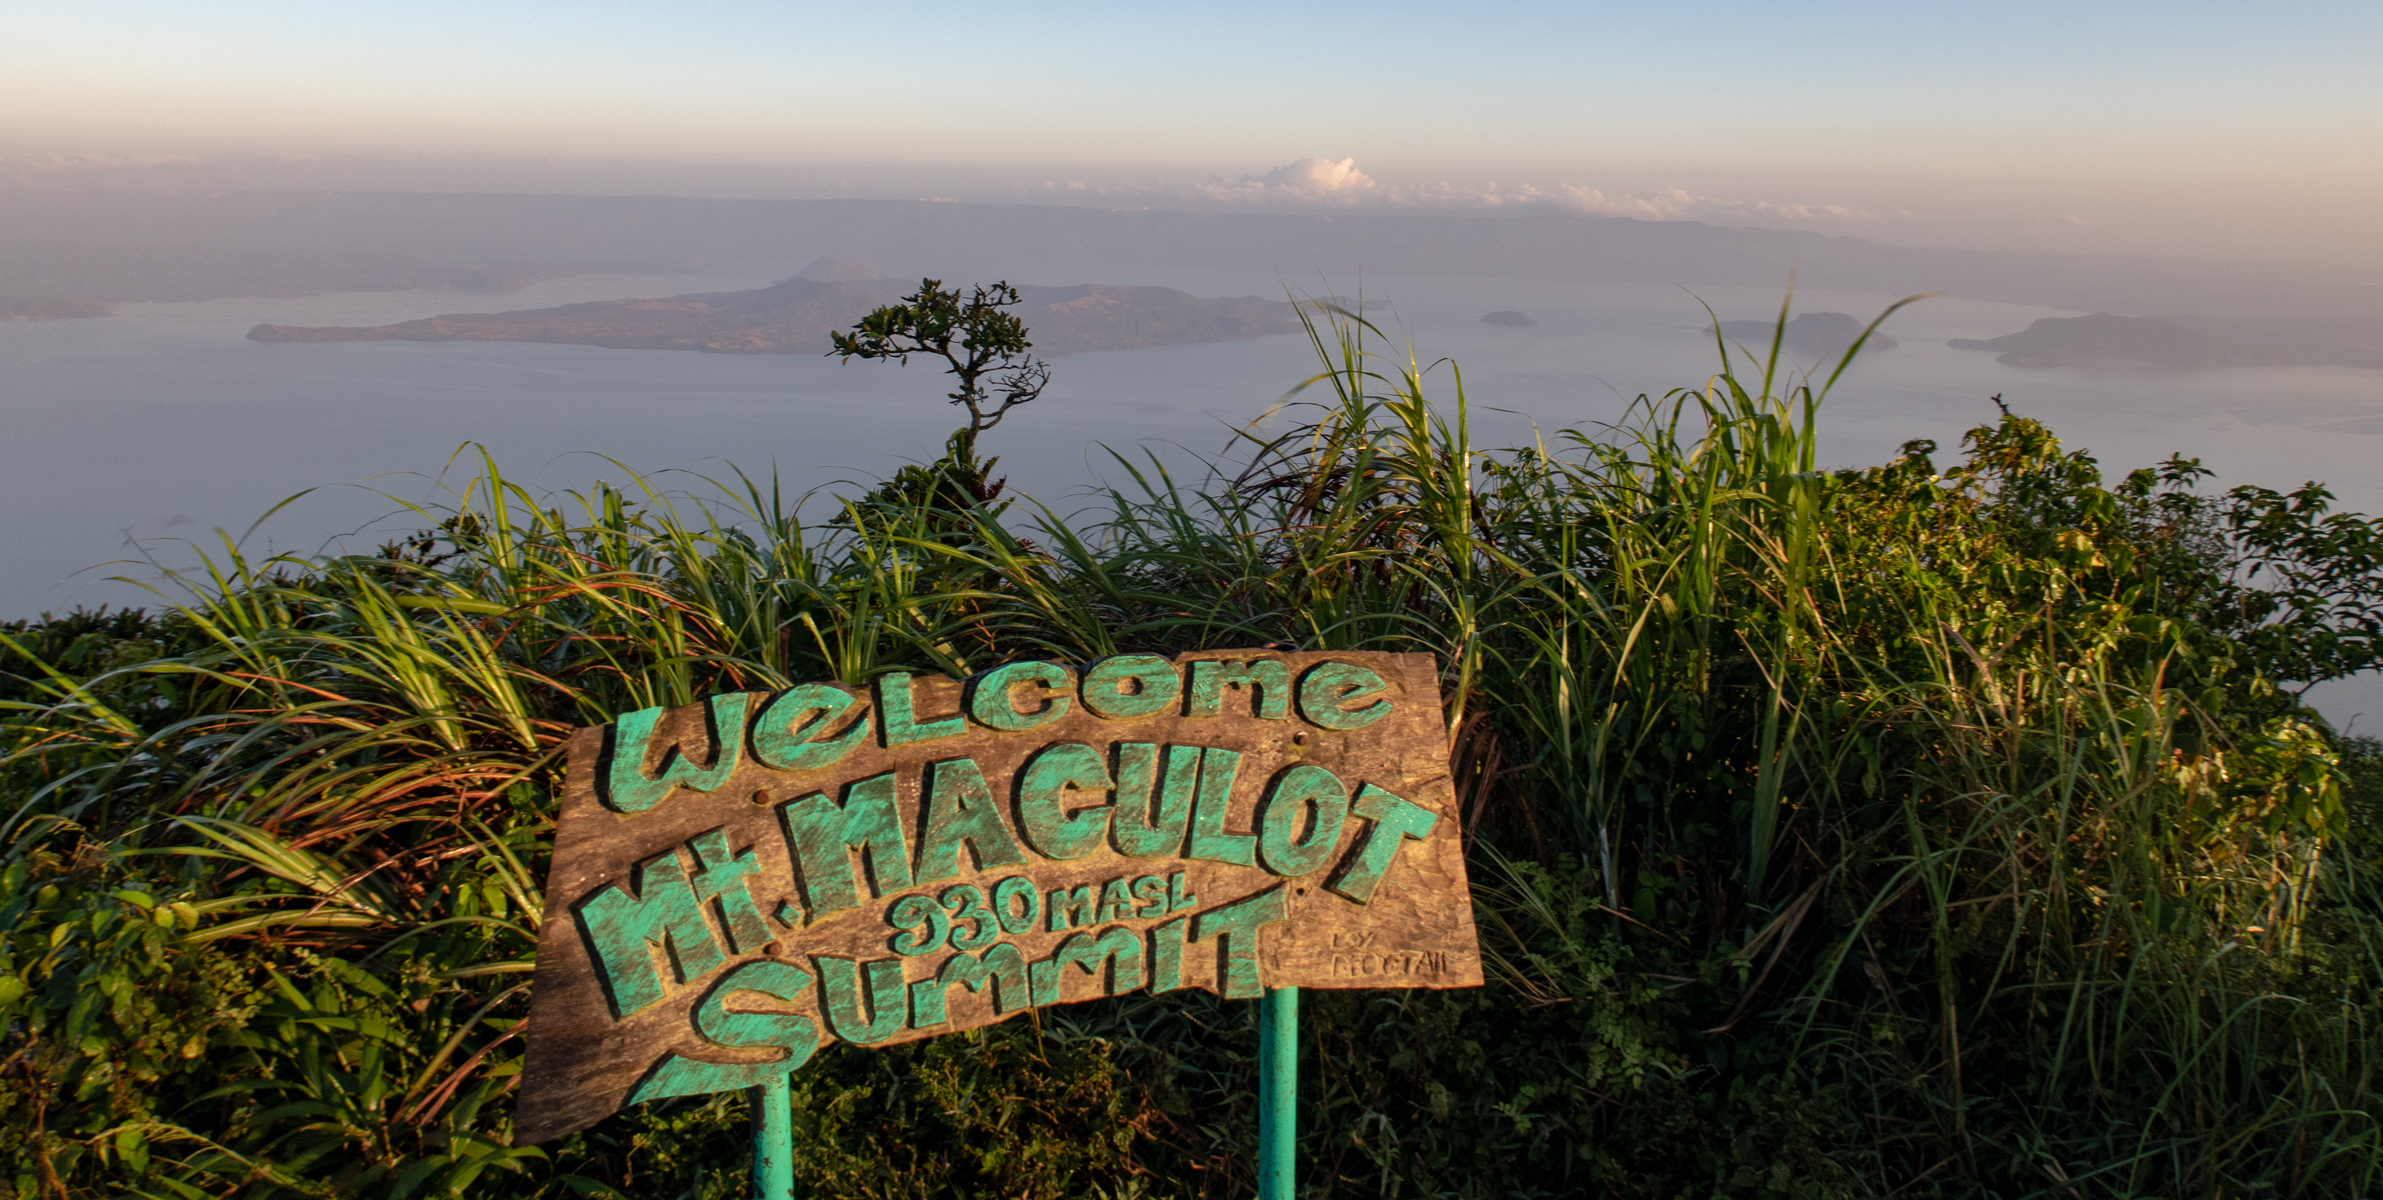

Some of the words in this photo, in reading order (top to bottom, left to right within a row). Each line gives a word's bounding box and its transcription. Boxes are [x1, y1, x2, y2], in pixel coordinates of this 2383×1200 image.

[775, 741, 1438, 925] MACULOT
[884, 873, 1040, 957] 930
[1045, 868, 1197, 933] MASL
